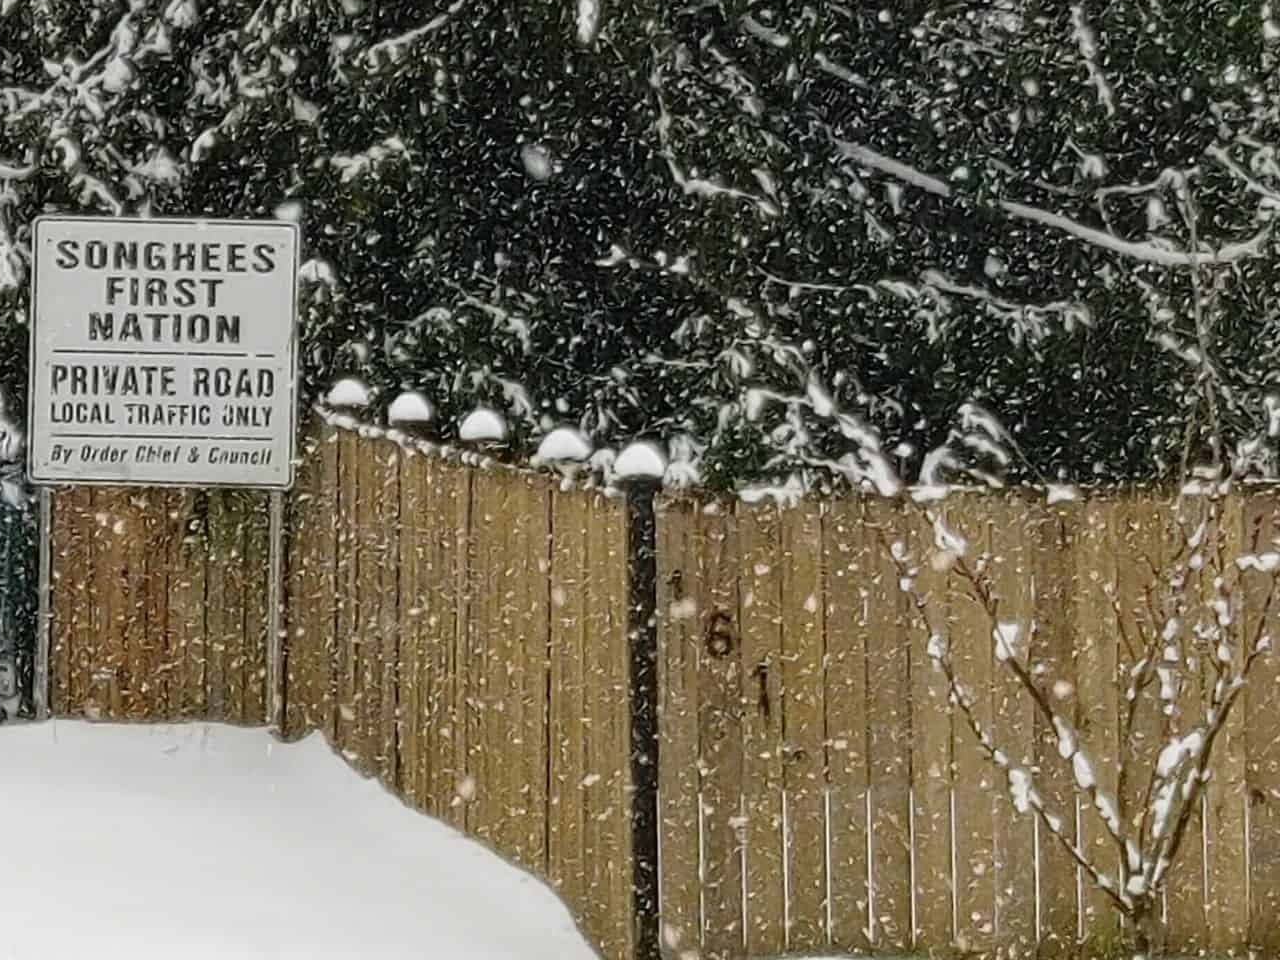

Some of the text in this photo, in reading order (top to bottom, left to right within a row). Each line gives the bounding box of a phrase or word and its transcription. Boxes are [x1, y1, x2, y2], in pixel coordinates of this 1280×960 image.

[55, 240, 276, 273] SONGHEES
[105, 277, 225, 307] FIRST
[88, 312, 241, 343] NATION
[51, 364, 275, 398] PRIVATE ROAD
[51, 401, 273, 427] LOCAL TRAFFIC ONLY
[51, 444, 273, 465] By Order Chief & Council
